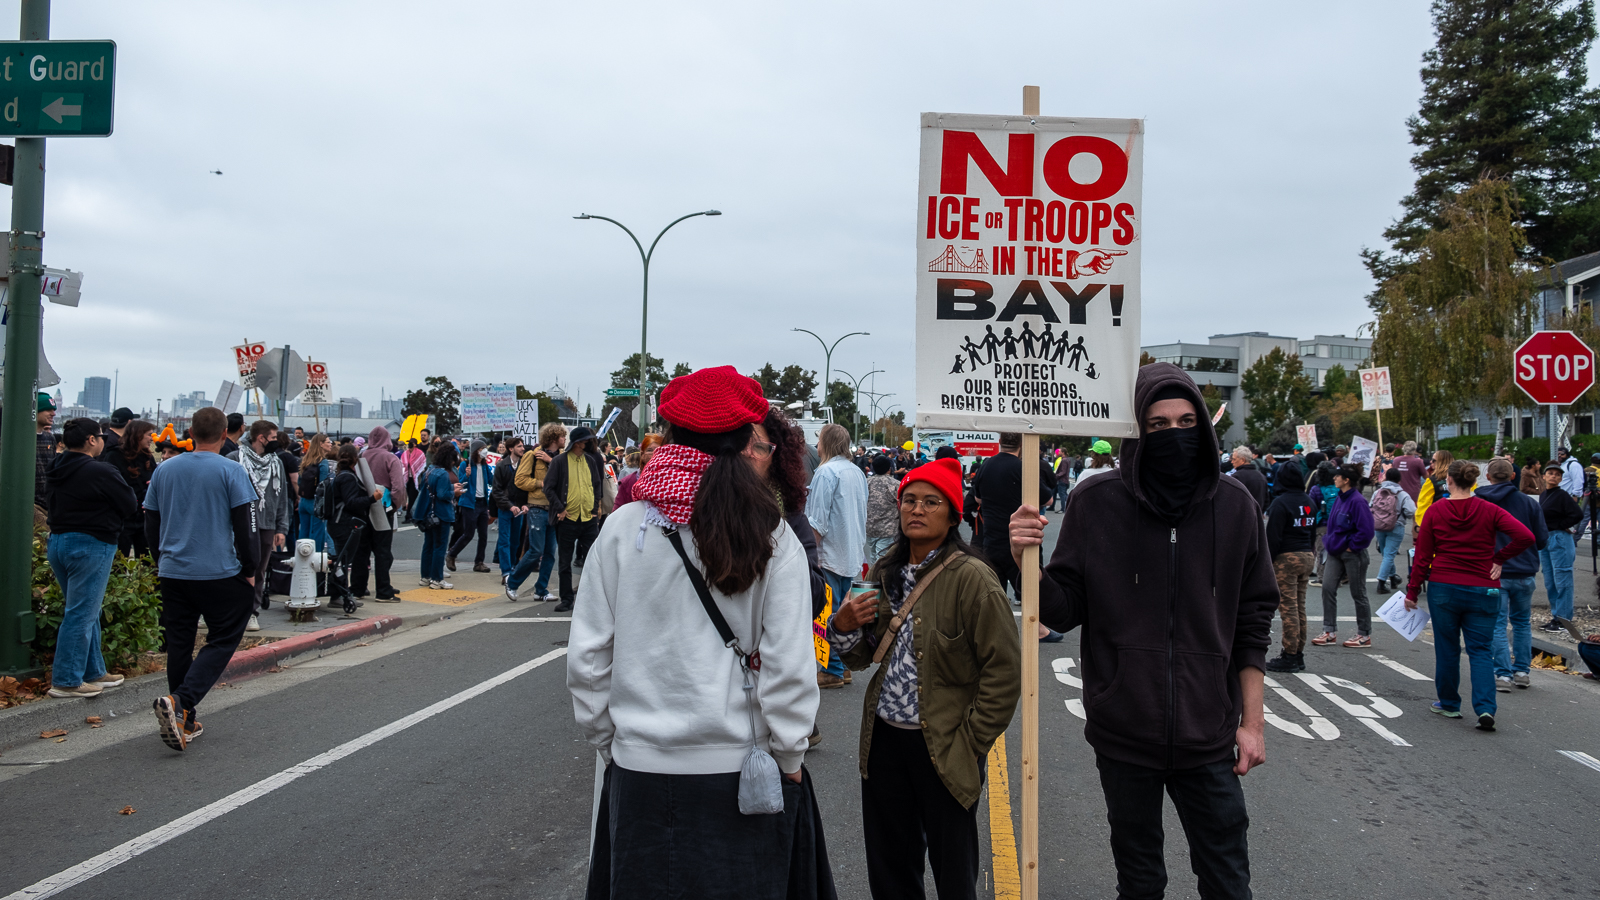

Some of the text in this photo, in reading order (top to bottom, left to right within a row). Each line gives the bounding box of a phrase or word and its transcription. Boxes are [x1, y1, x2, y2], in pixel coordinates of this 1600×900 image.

[0, 54, 104, 82] t Guard
[0, 96, 18, 122] d
[940, 129, 1128, 202] NO
[926, 196, 1135, 246] ICE OR TROOPS
[992, 246, 1064, 278] IN THE
[936, 278, 1124, 326] BAY!
[236, 344, 264, 358] NO
[240, 368, 256, 377] BA
[994, 363, 1056, 381] PROTECT
[1519, 354, 1590, 381] STOP
[964, 379, 1082, 402] OUR NEIGHBORS,
[941, 394, 1110, 419] RIGHTS & CONSTITUTION
[514, 423, 537, 434] NAZI
[1299, 506, 1304, 515] I
